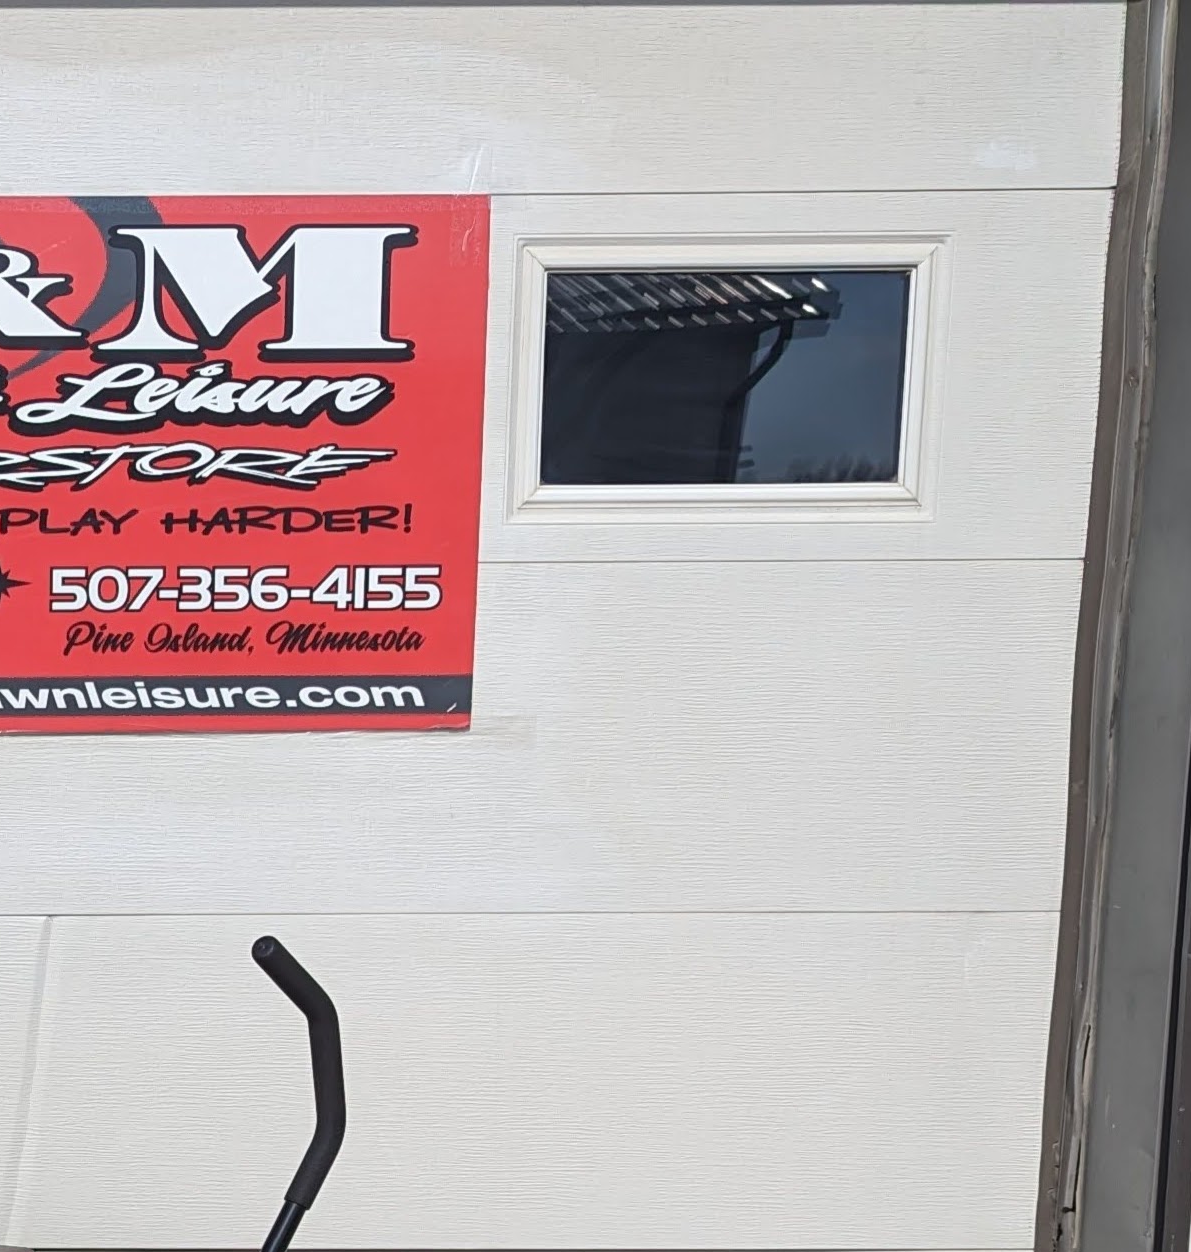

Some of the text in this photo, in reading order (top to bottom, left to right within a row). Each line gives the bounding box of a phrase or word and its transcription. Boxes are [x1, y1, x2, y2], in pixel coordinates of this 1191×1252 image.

[11, 362, 389, 430] Leisure
[160, 503, 413, 535] HARDER!
[49, 565, 442, 612] 507-356-4155
[63, 620, 425, 656] Pine Island, Minnesota
